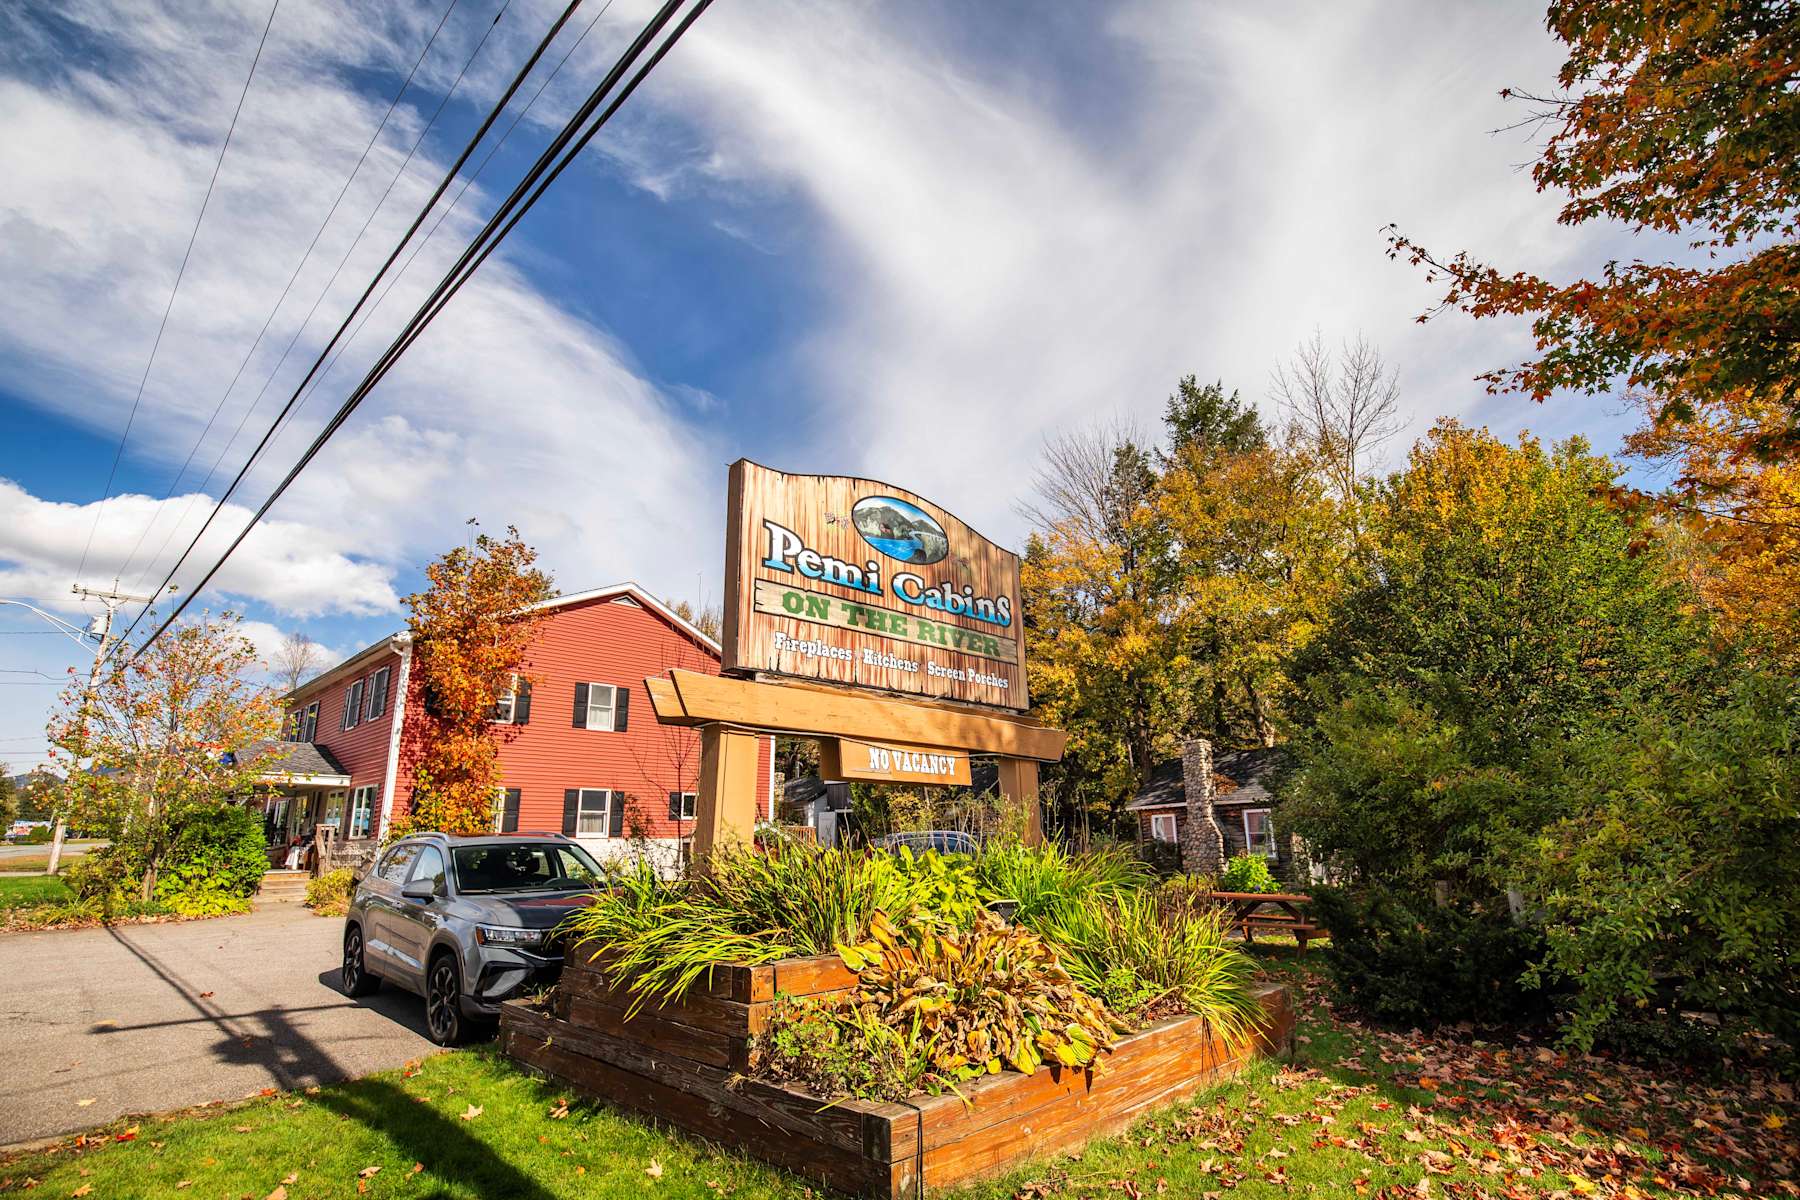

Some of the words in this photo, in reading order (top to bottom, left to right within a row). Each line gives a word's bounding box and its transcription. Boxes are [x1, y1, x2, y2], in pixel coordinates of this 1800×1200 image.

[762, 518, 884, 597] Pemi
[783, 591, 830, 620] ON
[841, 602, 908, 636] THE
[917, 620, 1001, 658] RIVER
[775, 631, 853, 661] Fireplaces
[863, 648, 919, 673] Kitchens
[927, 661, 966, 681] Screen
[967, 668, 1009, 689] Porches
[869, 747, 890, 770] NO
[892, 751, 956, 776] VACANCY
